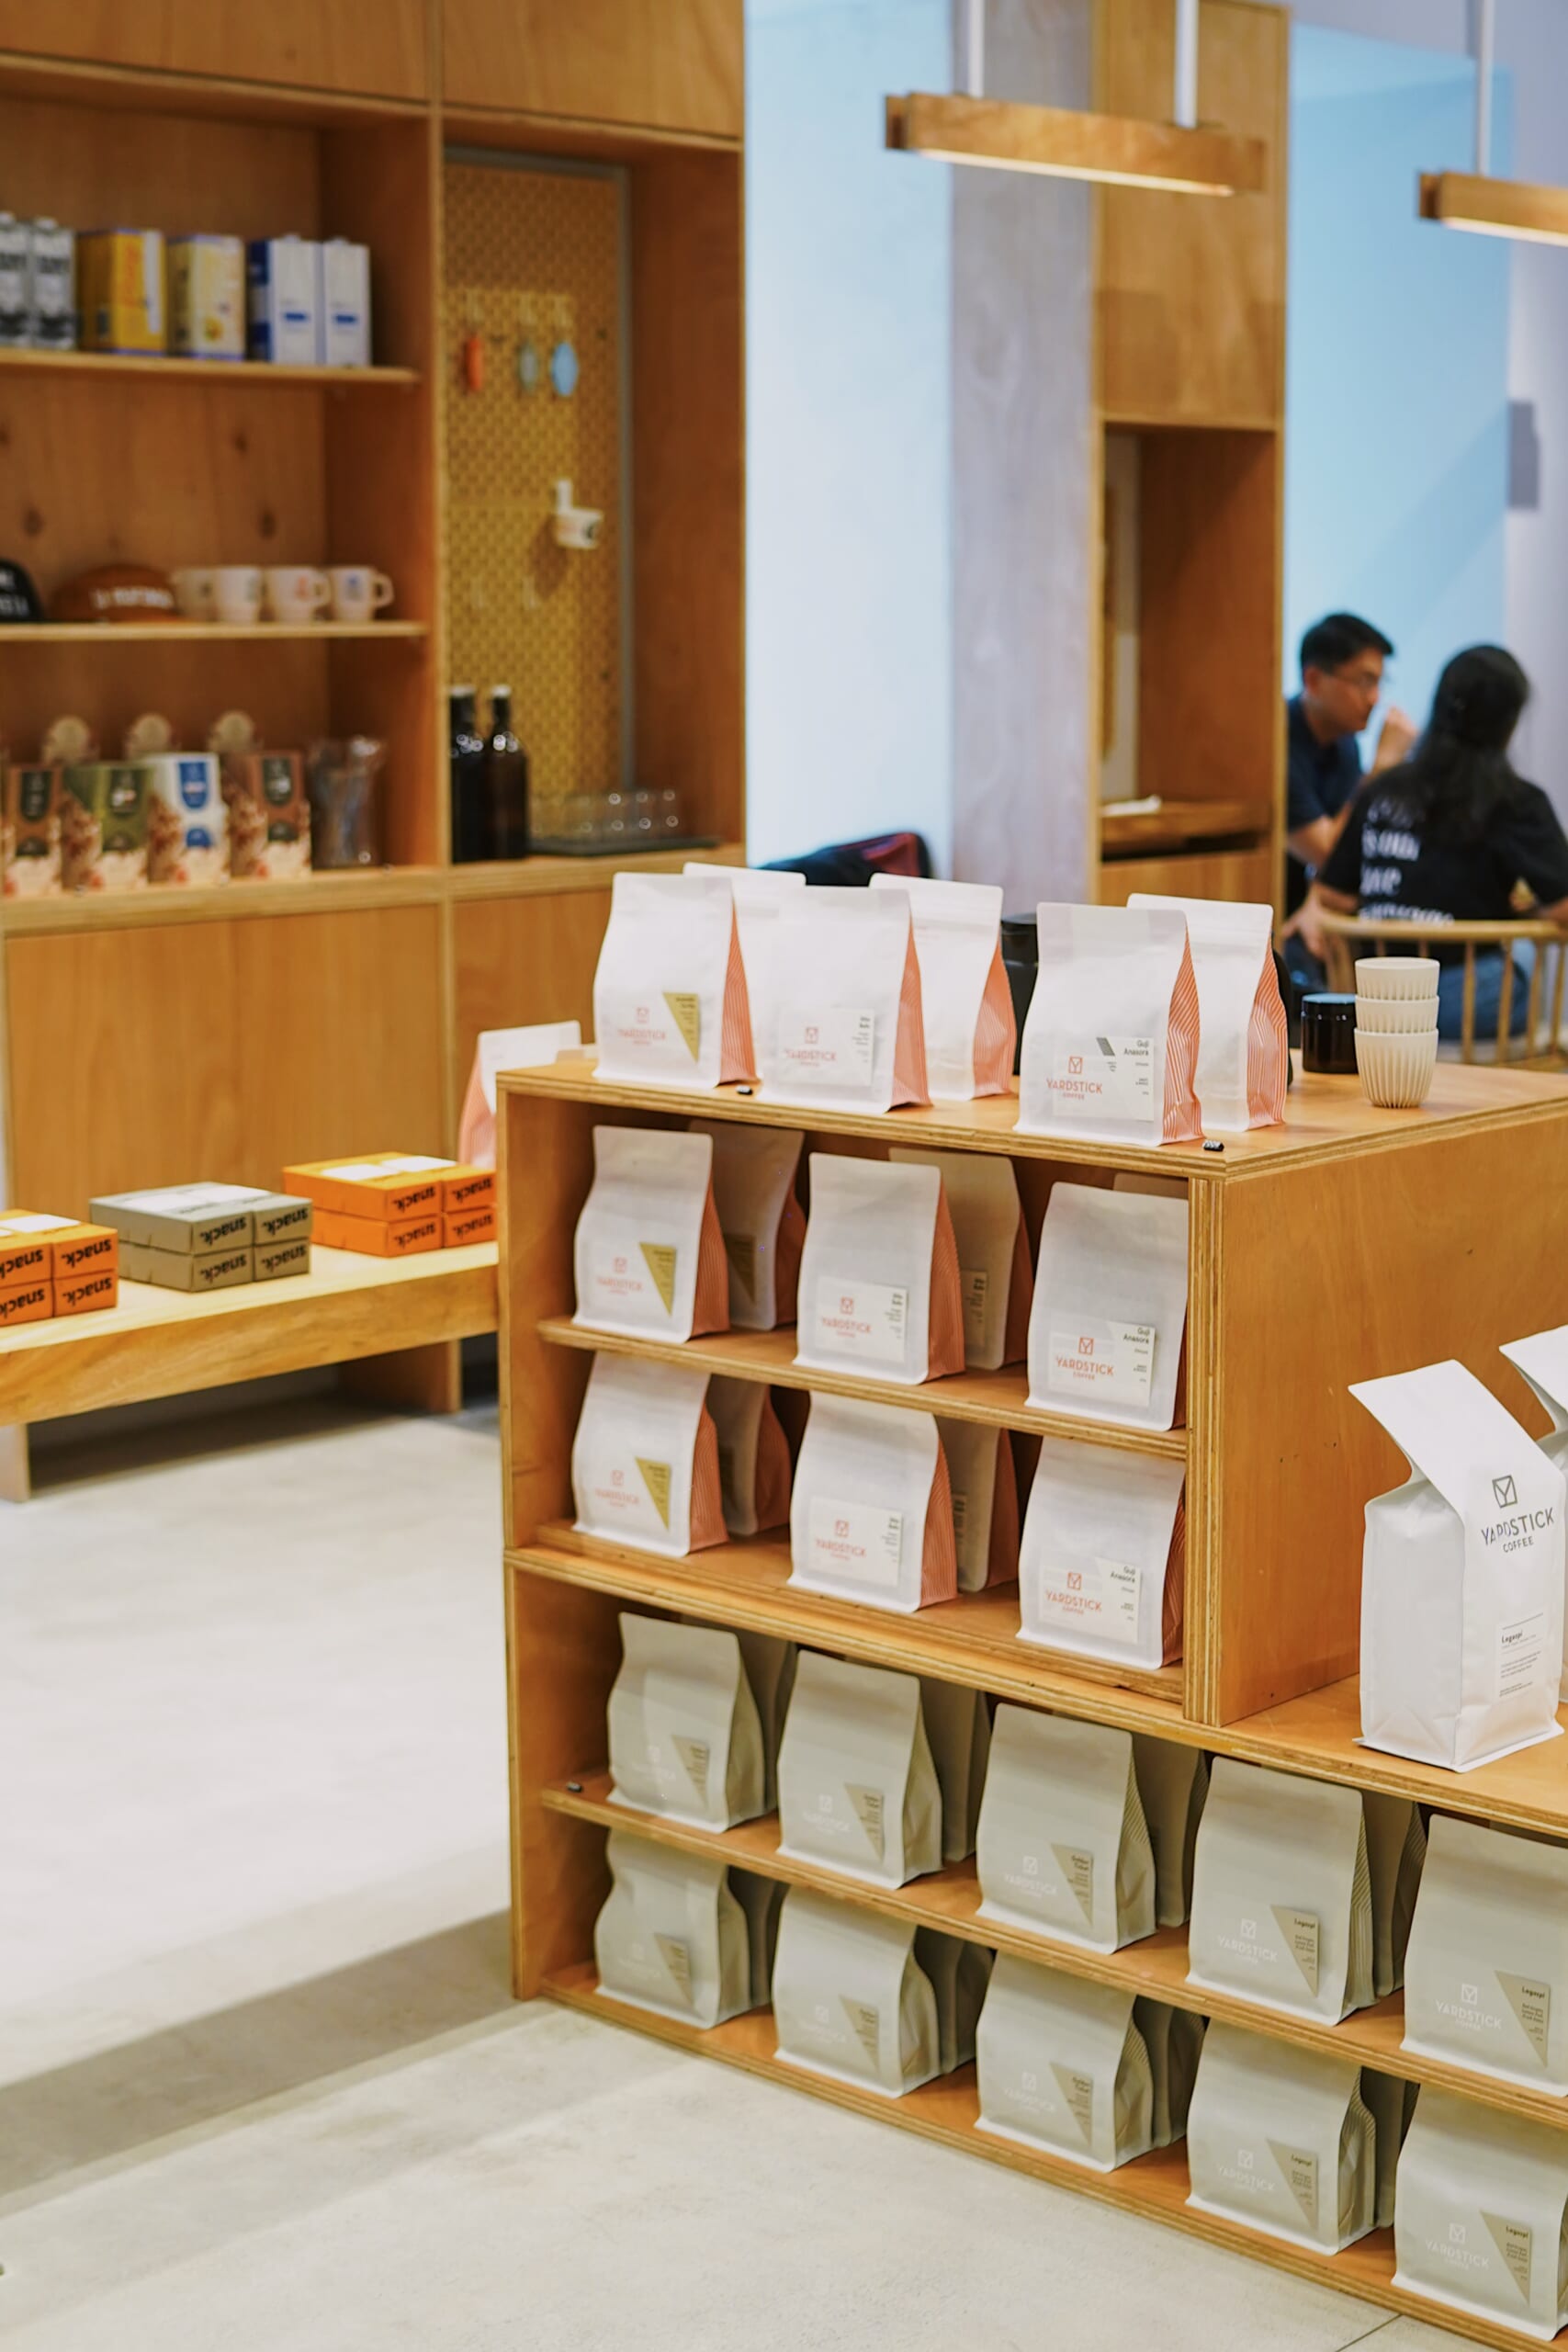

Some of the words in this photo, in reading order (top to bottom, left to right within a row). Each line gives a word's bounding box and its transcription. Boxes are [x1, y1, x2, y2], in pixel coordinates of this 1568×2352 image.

[1046, 1078, 1103, 1094] YARDSTICK
[61, 1238, 112, 1269] snack.
[62, 1277, 113, 1306] snack.
[1056, 1356, 1114, 1376] YARDSTICK
[1481, 1507, 1554, 1545] YARDSTICK
[1503, 1536, 1534, 1553] COFFEE
[1045, 1589, 1102, 1613] YARDSTICK
[1217, 1933, 1279, 1963] YARDSTICK
[1435, 1999, 1502, 2030] YARDSTICK
[1425, 2239, 1490, 2268] YARDSTICK
